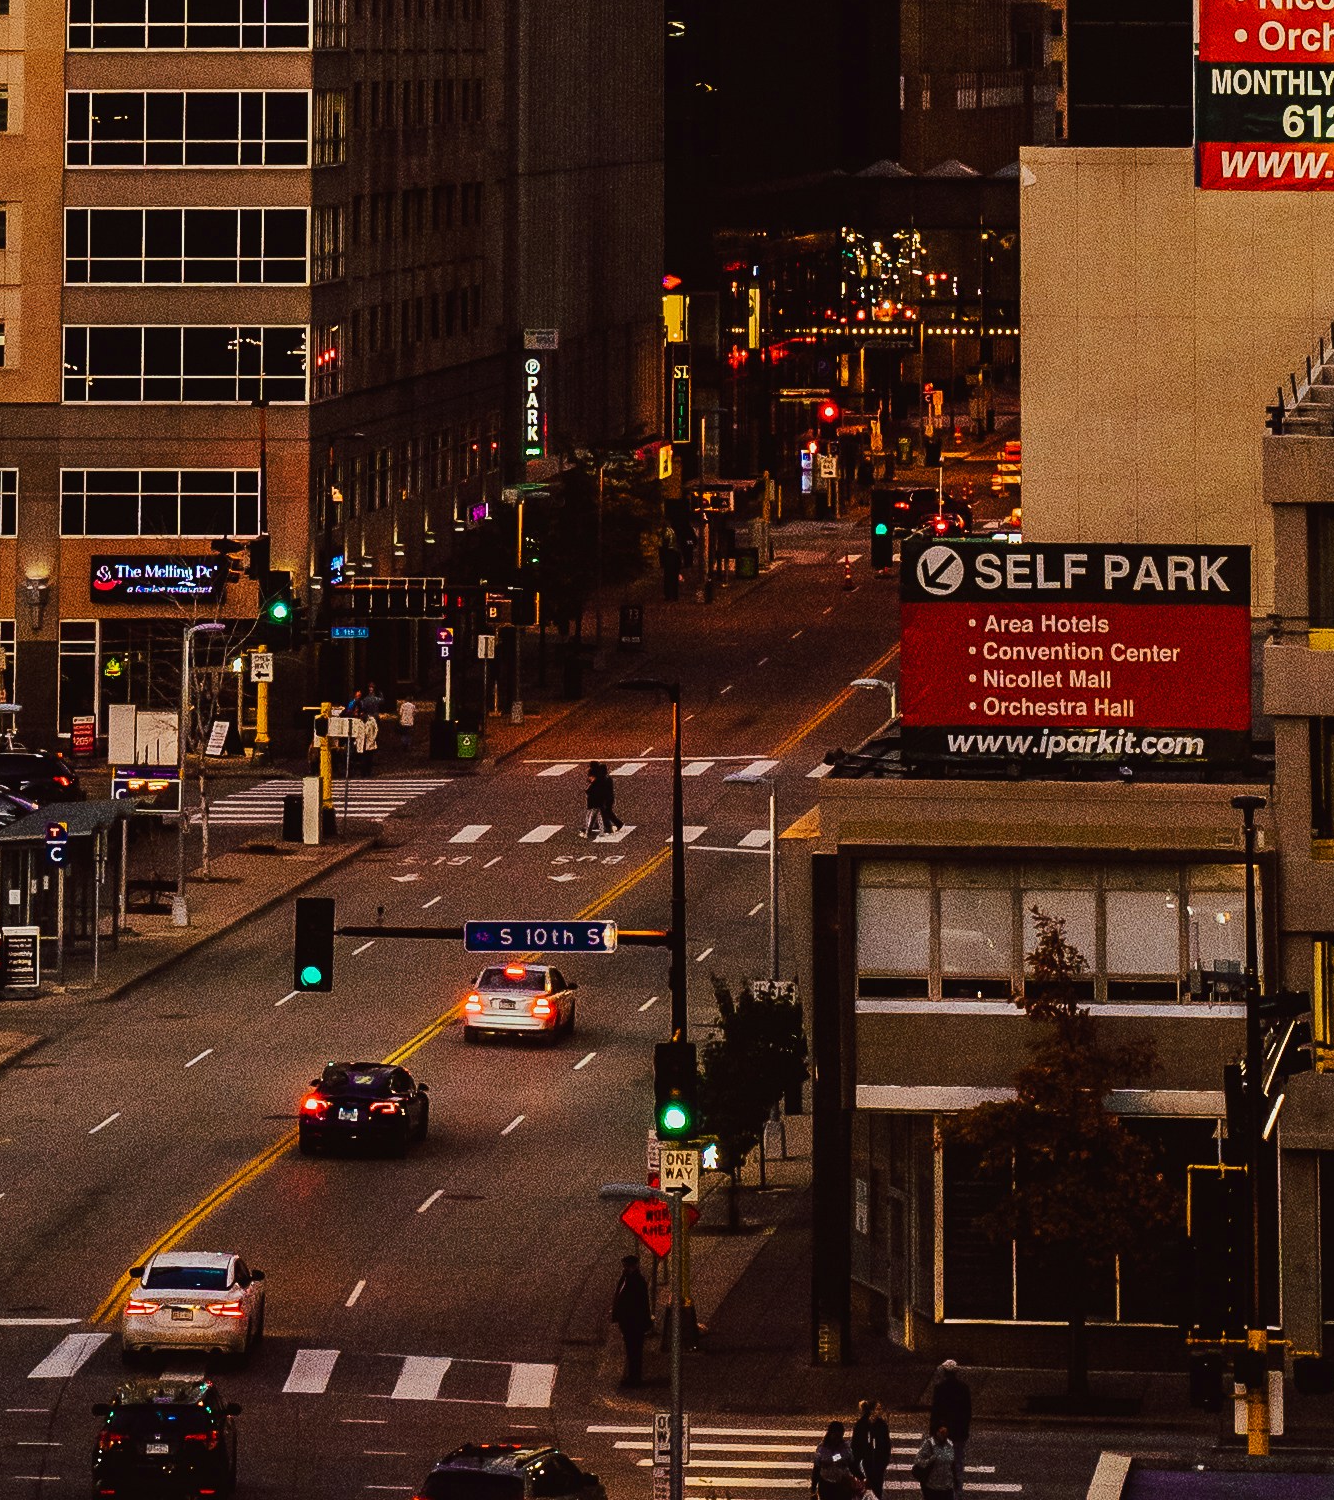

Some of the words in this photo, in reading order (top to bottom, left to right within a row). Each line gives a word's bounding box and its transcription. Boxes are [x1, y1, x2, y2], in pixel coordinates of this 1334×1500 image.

[526, 376, 539, 442] PARK
[115, 565, 142, 578] The
[145, 565, 193, 581] Melting
[975, 554, 1087, 589] SELF
[1104, 554, 1230, 592] PARK
[167, 585, 213, 593] restaurant
[490, 607, 497, 618] B
[984, 615, 1034, 633] Area
[1041, 615, 1109, 633] Hotels
[441, 646, 449, 657] B
[983, 642, 1103, 661] Convention
[1111, 643, 1181, 662] Center
[983, 669, 1063, 688] Nicollet
[1069, 670, 1112, 689] Mall
[983, 697, 1087, 716] Orchestra
[1094, 698, 1135, 717] Hall
[947, 729, 1204, 759] www.iparkit.com
[50, 847, 63, 861] C
[500, 929, 513, 945] S
[525, 929, 574, 945] 10th
[667, 1151, 692, 1166] ONE
[665, 1167, 694, 1180] WAY
[646, 1209, 668, 1221] WOR
[642, 1225, 672, 1236] AHEA
